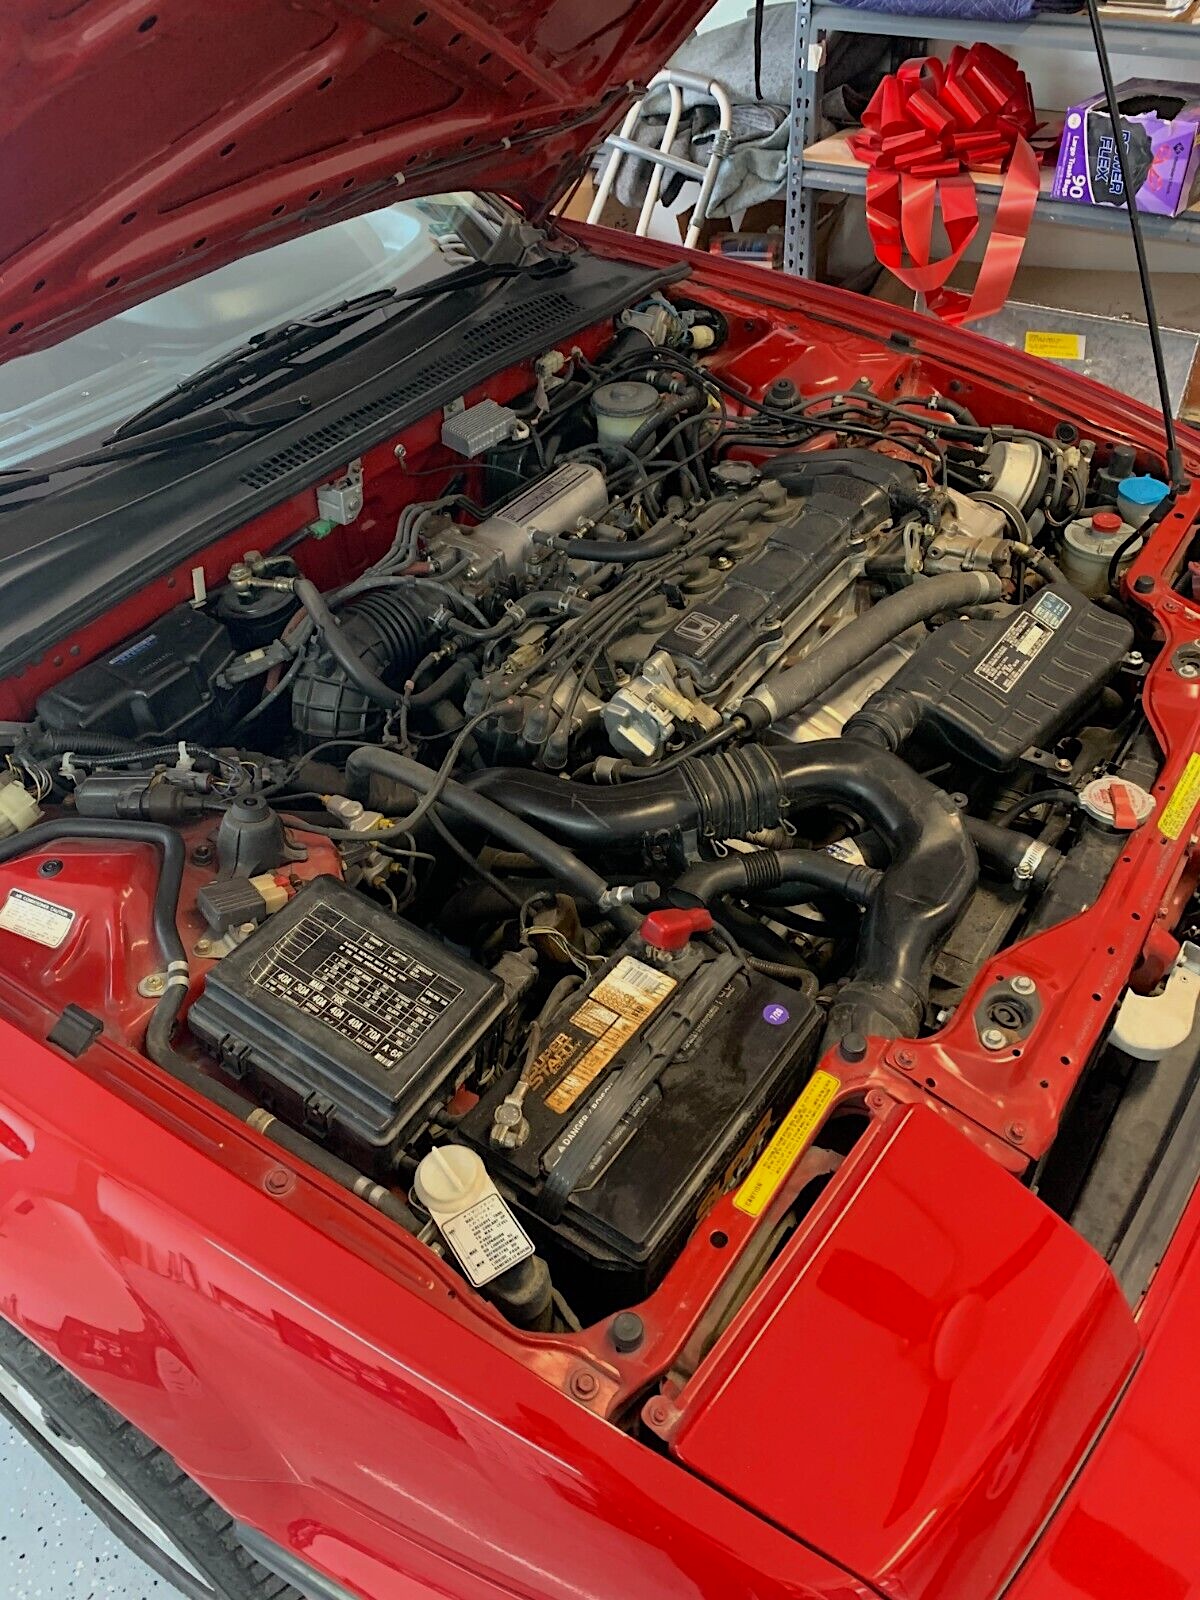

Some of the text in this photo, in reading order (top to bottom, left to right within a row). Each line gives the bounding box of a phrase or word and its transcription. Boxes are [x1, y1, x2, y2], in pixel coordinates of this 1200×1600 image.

[1070, 135, 1080, 157] Large
[1095, 135, 1114, 183] FLEX
[1069, 174, 1087, 199] 90
[275, 971, 293, 985] 40A
[293, 982, 310, 997] 30A
[308, 978, 325, 992] MAIN
[330, 992, 347, 1006] FUSE
[310, 993, 328, 1007] 40A
[327, 1004, 346, 1019] 40A
[346, 1016, 364, 1030] 40A
[364, 1027, 382, 1042] 70A
[529, 1037, 575, 1091] START
[562, 1114, 589, 1146] DANGER
